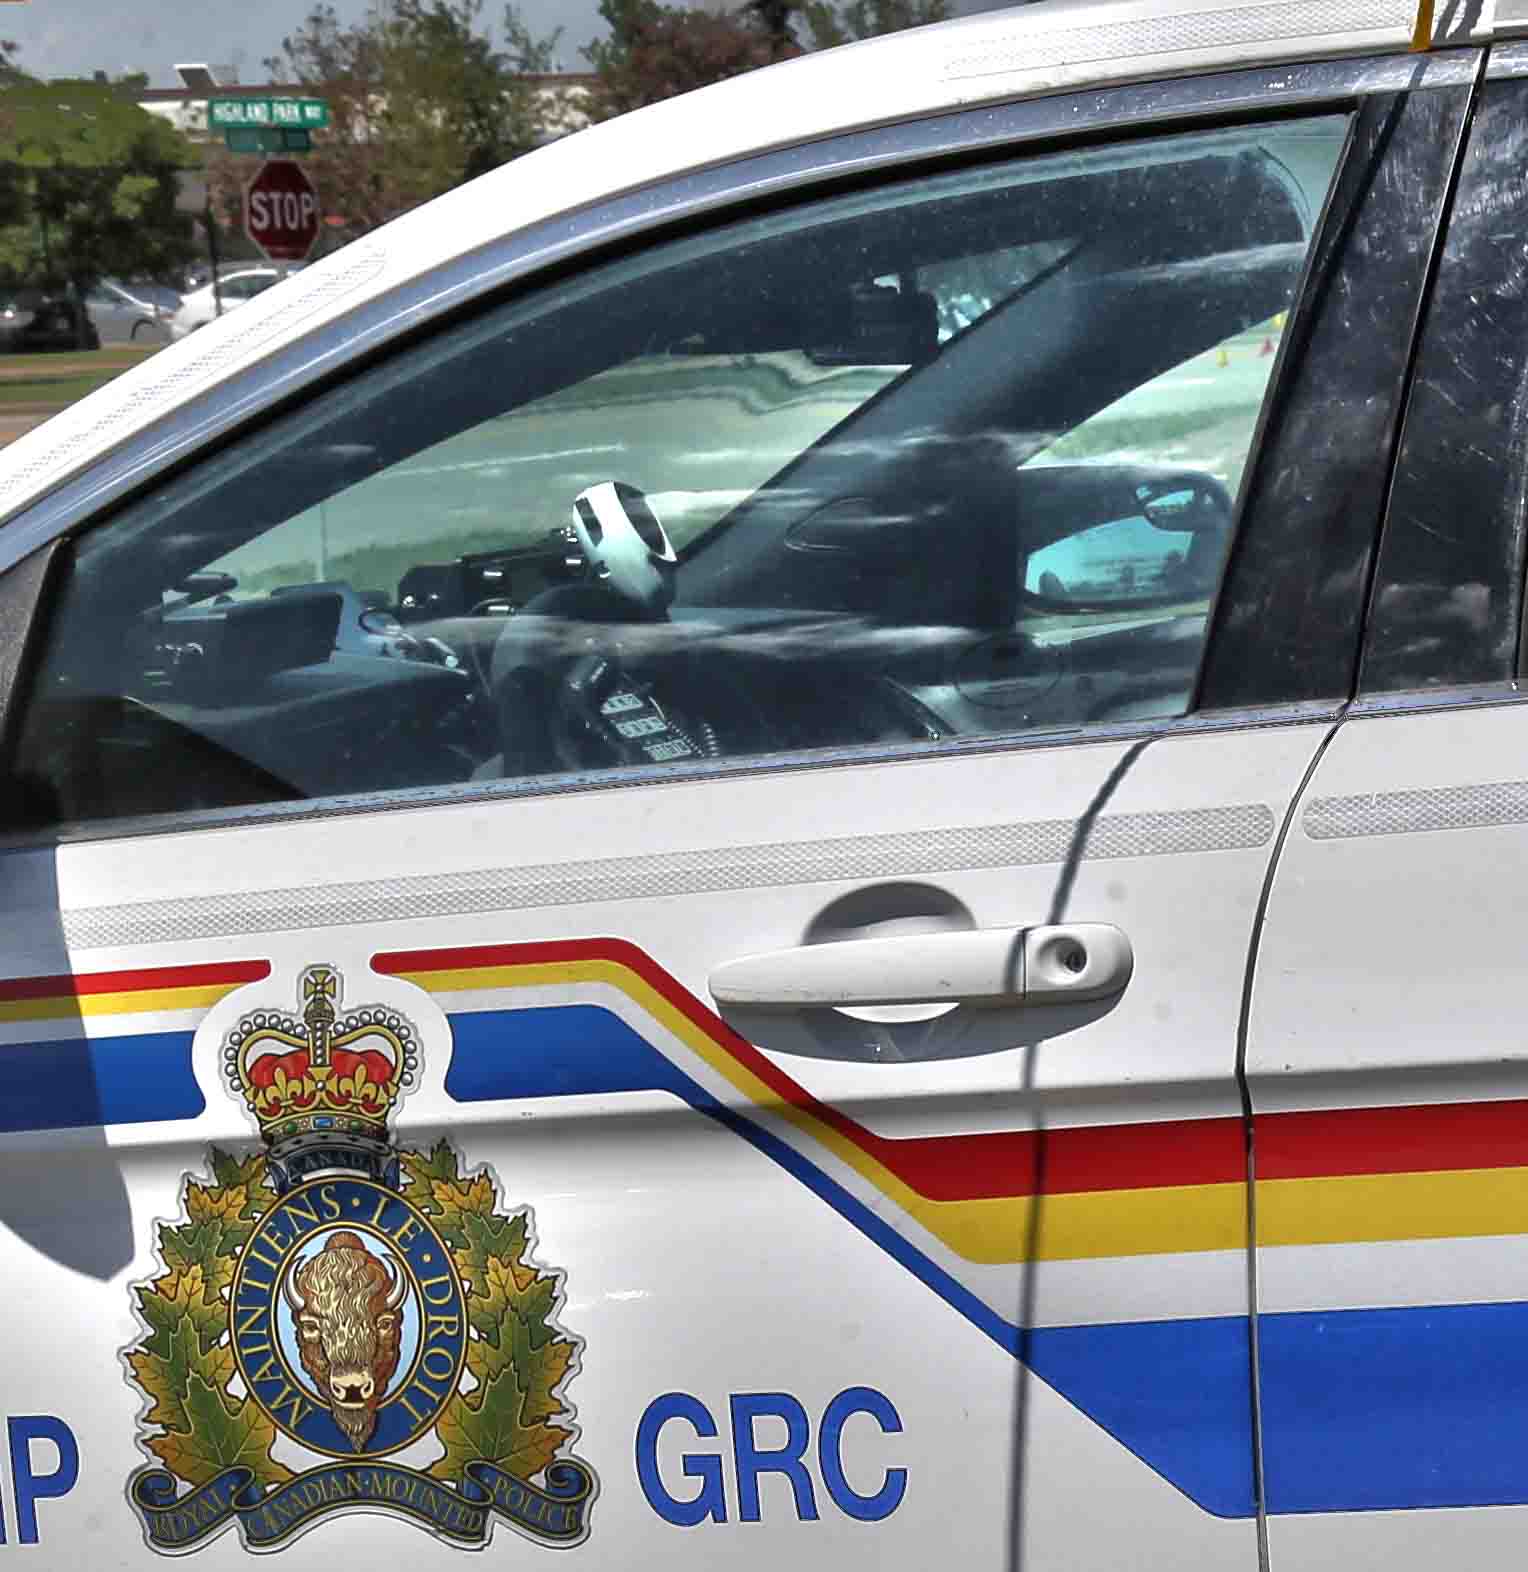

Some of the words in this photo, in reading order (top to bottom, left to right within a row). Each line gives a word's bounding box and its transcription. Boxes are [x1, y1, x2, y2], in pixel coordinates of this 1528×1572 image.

[251, 191, 313, 231] STOP
[238, 1184, 342, 1430] MAINTIENS
[371, 1197, 424, 1251] LE
[399, 1273, 459, 1431] DROIT
[634, 1386, 909, 1527] GRC
